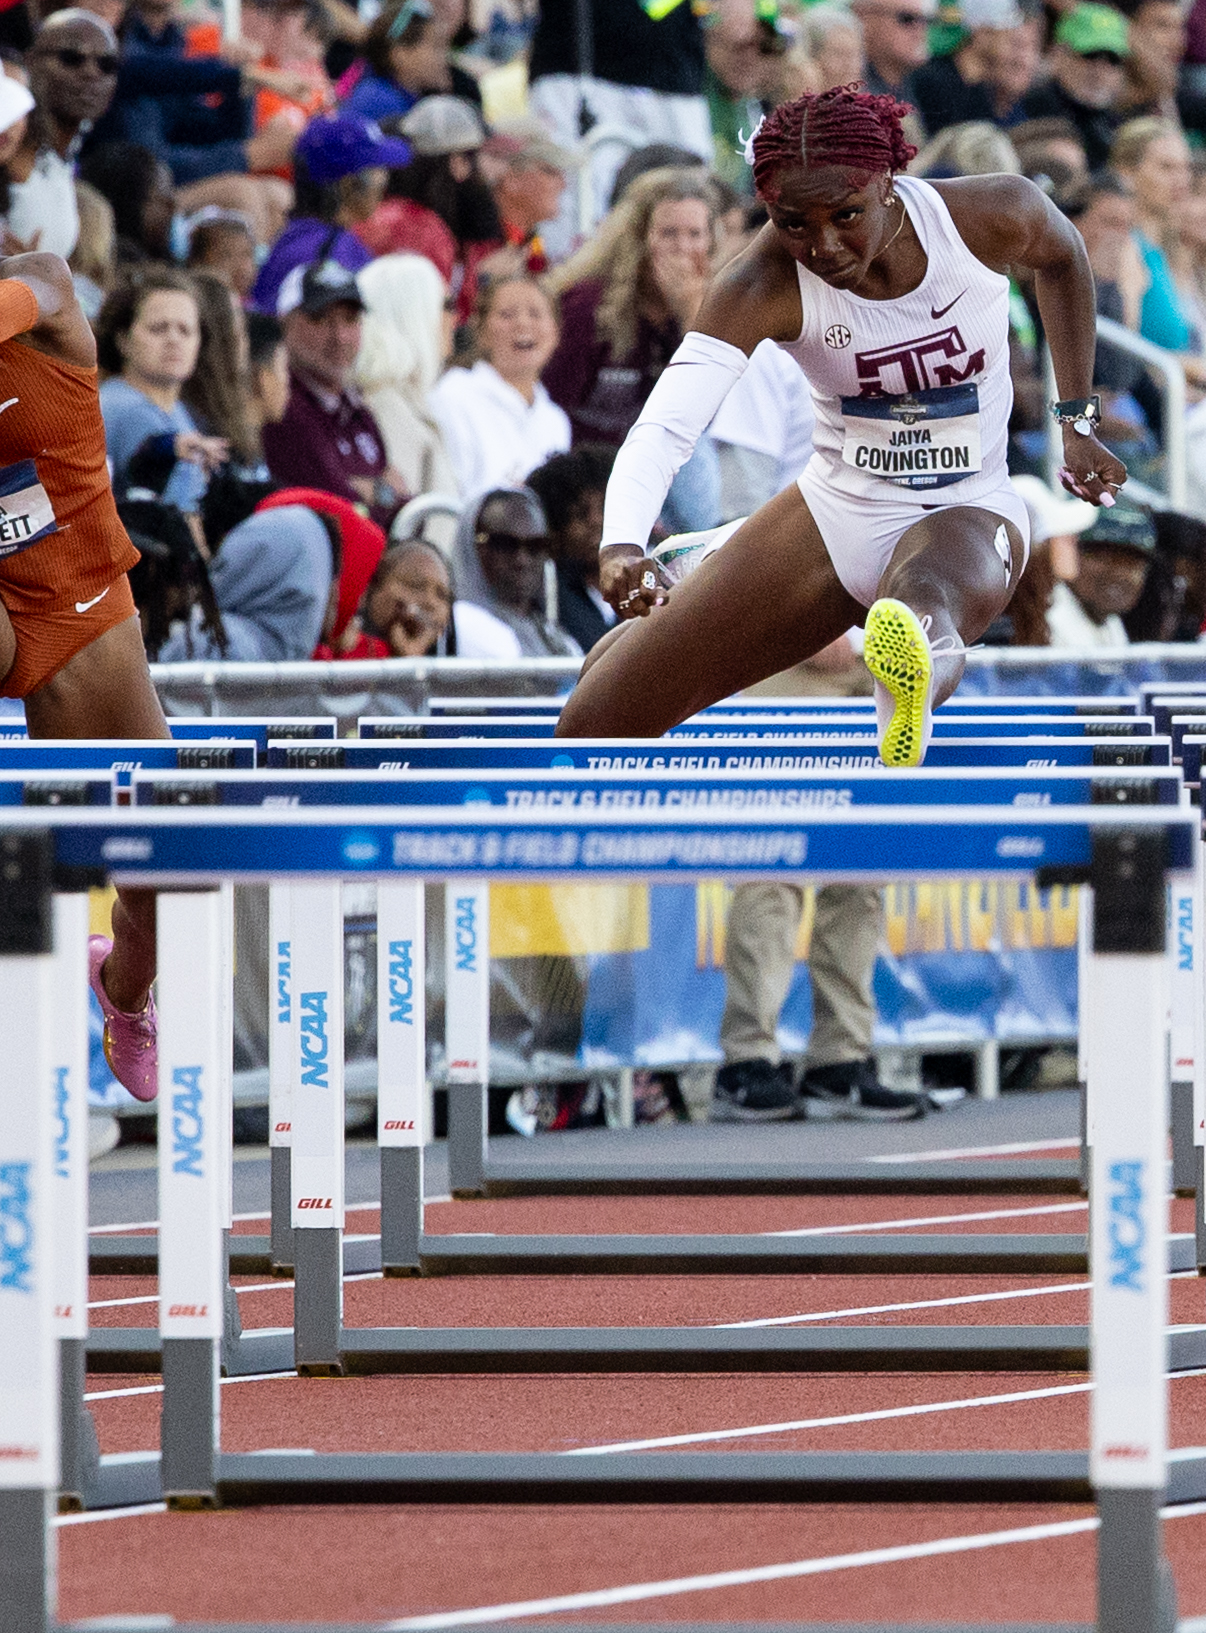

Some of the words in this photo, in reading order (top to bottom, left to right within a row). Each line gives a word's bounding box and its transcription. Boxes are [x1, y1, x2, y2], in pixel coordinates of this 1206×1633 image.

[825, 325, 851, 349] SEC
[889, 428, 932, 447] JAIYA
[855, 445, 970, 472] COVINGTON
[587, 757, 650, 769] TRACK
[668, 757, 721, 769] FIELD
[665, 789, 853, 808] CHAMPIONSHIPS
[455, 897, 477, 973] NCAA
[389, 939, 413, 1025] NCAA
[300, 992, 328, 1088] NCAA
[172, 1066, 204, 1177] NCAA
[275, 1123, 291, 1132] GI
[384, 1120, 415, 1130] GILL
[297, 1198, 333, 1209] GILL
[1108, 1160, 1144, 1291] NCAA
